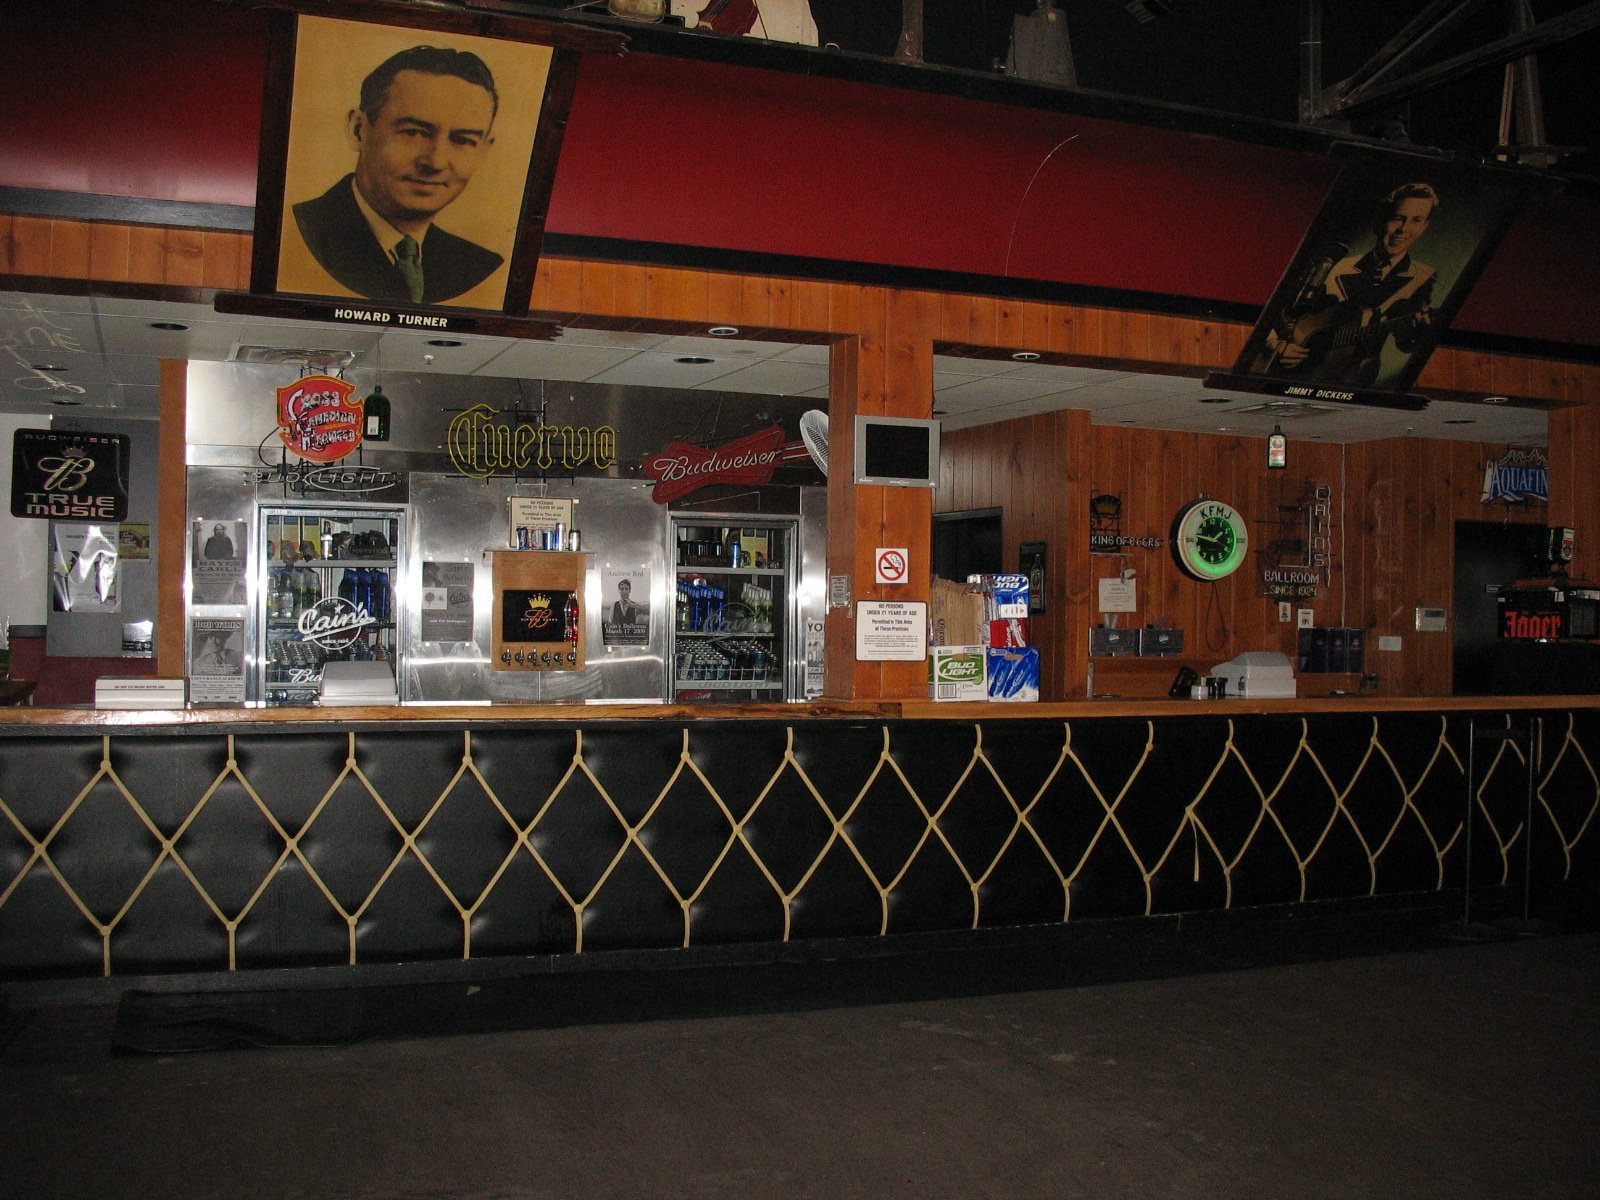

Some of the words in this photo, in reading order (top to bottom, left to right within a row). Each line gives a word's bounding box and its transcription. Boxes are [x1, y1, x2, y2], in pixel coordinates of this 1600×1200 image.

[334, 308, 391, 322] HOWARD
[397, 314, 448, 328] TURNER
[1284, 386, 1314, 396] JIMMY
[1315, 389, 1355, 401] DICKENS
[448, 403, 616, 479] Cuervo
[653, 450, 783, 482] Budweiser
[250, 472, 300, 484] BUD
[318, 471, 392, 484] LIGHT
[1489, 460, 1549, 501] AQUAFIN
[24, 492, 115, 507] TRUE
[26, 504, 115, 518] MUSIC
[1200, 506, 1233, 519] KFMJ
[1091, 535, 1114, 545] KING
[1116, 536, 1127, 545] OF
[1264, 570, 1320, 585] BALLROOM
[1269, 585, 1295, 595] SINCE
[1297, 585, 1318, 597] 1924
[298, 601, 376, 635] Cain's
[942, 668, 979, 676] LIGHT
[947, 661, 976, 669] BUD
